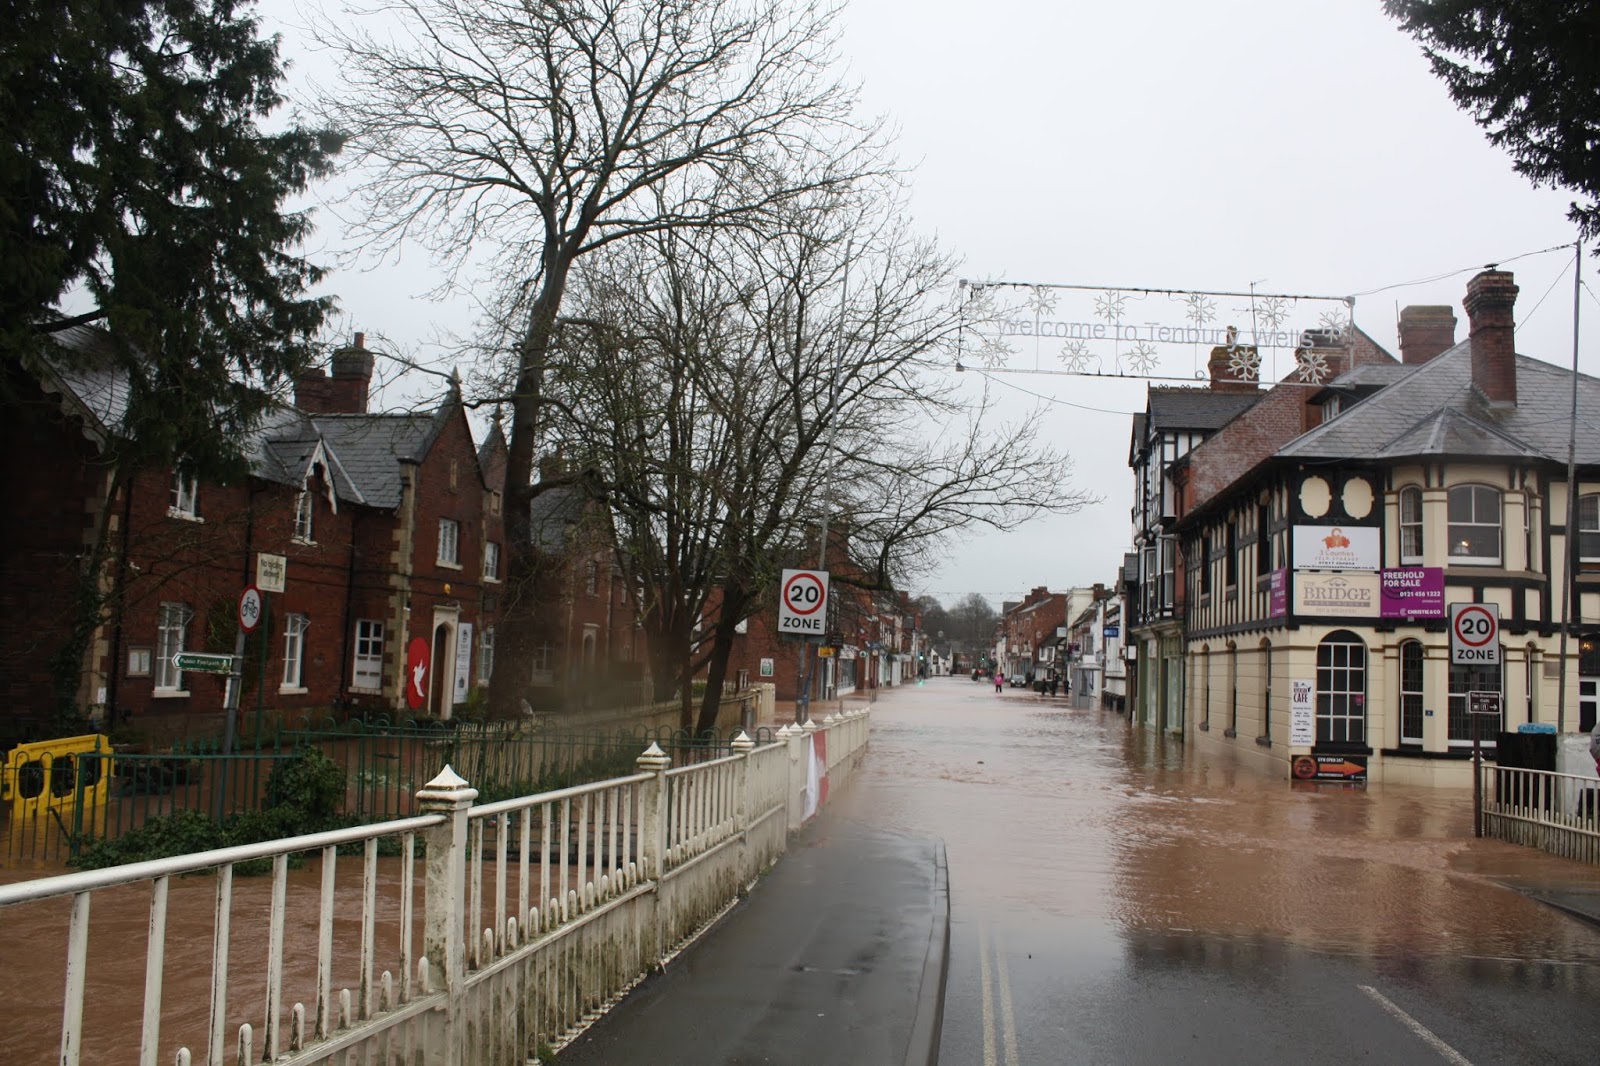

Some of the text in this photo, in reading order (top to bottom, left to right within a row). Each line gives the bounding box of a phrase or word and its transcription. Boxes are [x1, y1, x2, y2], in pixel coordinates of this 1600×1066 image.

[1001, 319, 1315, 352] Welcome to Tenbury Wells
[1325, 549, 1354, 557] Counties
[1383, 571, 1425, 580] FREEHOLD
[1383, 579, 1421, 588] FOR SALE
[791, 585, 819, 603] 20
[1303, 586, 1371, 601] BRIDGE
[783, 616, 821, 630] ZONE
[1462, 618, 1490, 635] 20
[1457, 649, 1494, 660] ZONE
